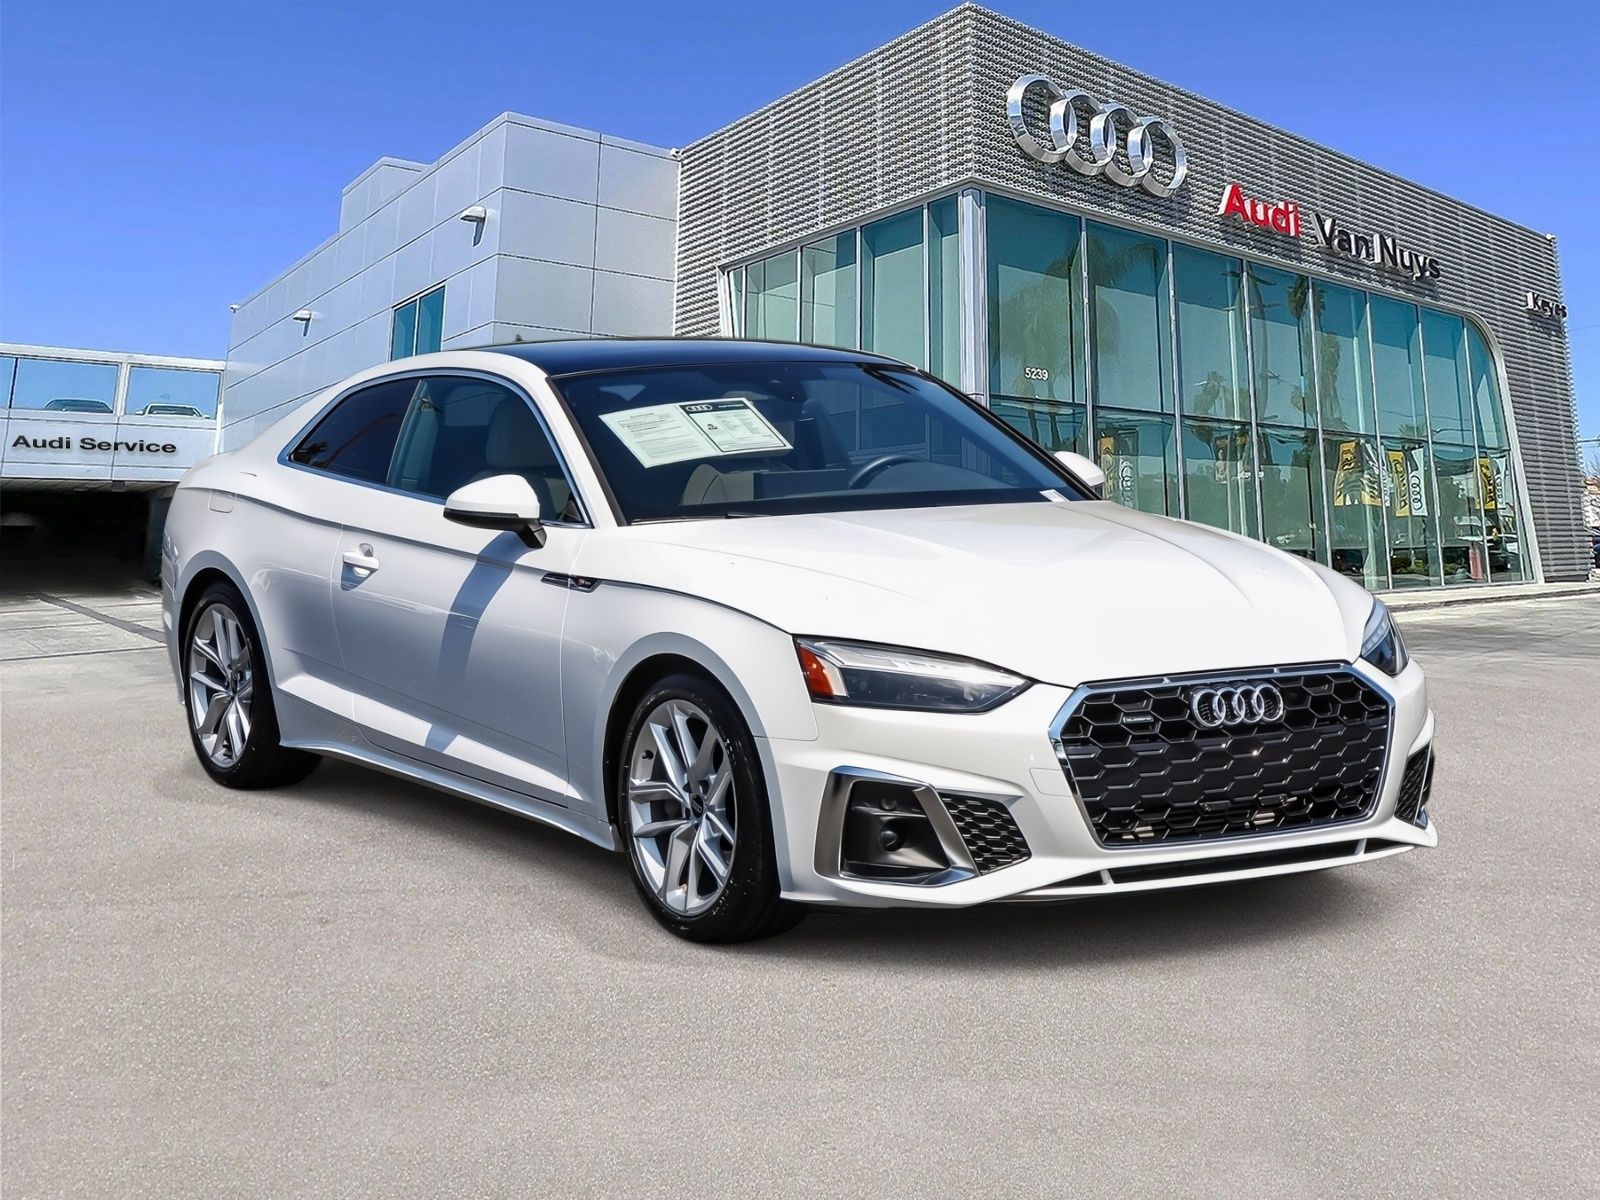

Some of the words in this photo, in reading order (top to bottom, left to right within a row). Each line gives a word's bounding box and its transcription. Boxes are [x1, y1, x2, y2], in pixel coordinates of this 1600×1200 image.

[1217, 182, 1302, 238] Audi
[1312, 212, 1371, 259] Van
[1374, 232, 1442, 281] Nuys
[1024, 367, 1048, 381] 5239
[12, 434, 71, 450] Audi
[79, 437, 177, 454] Service
